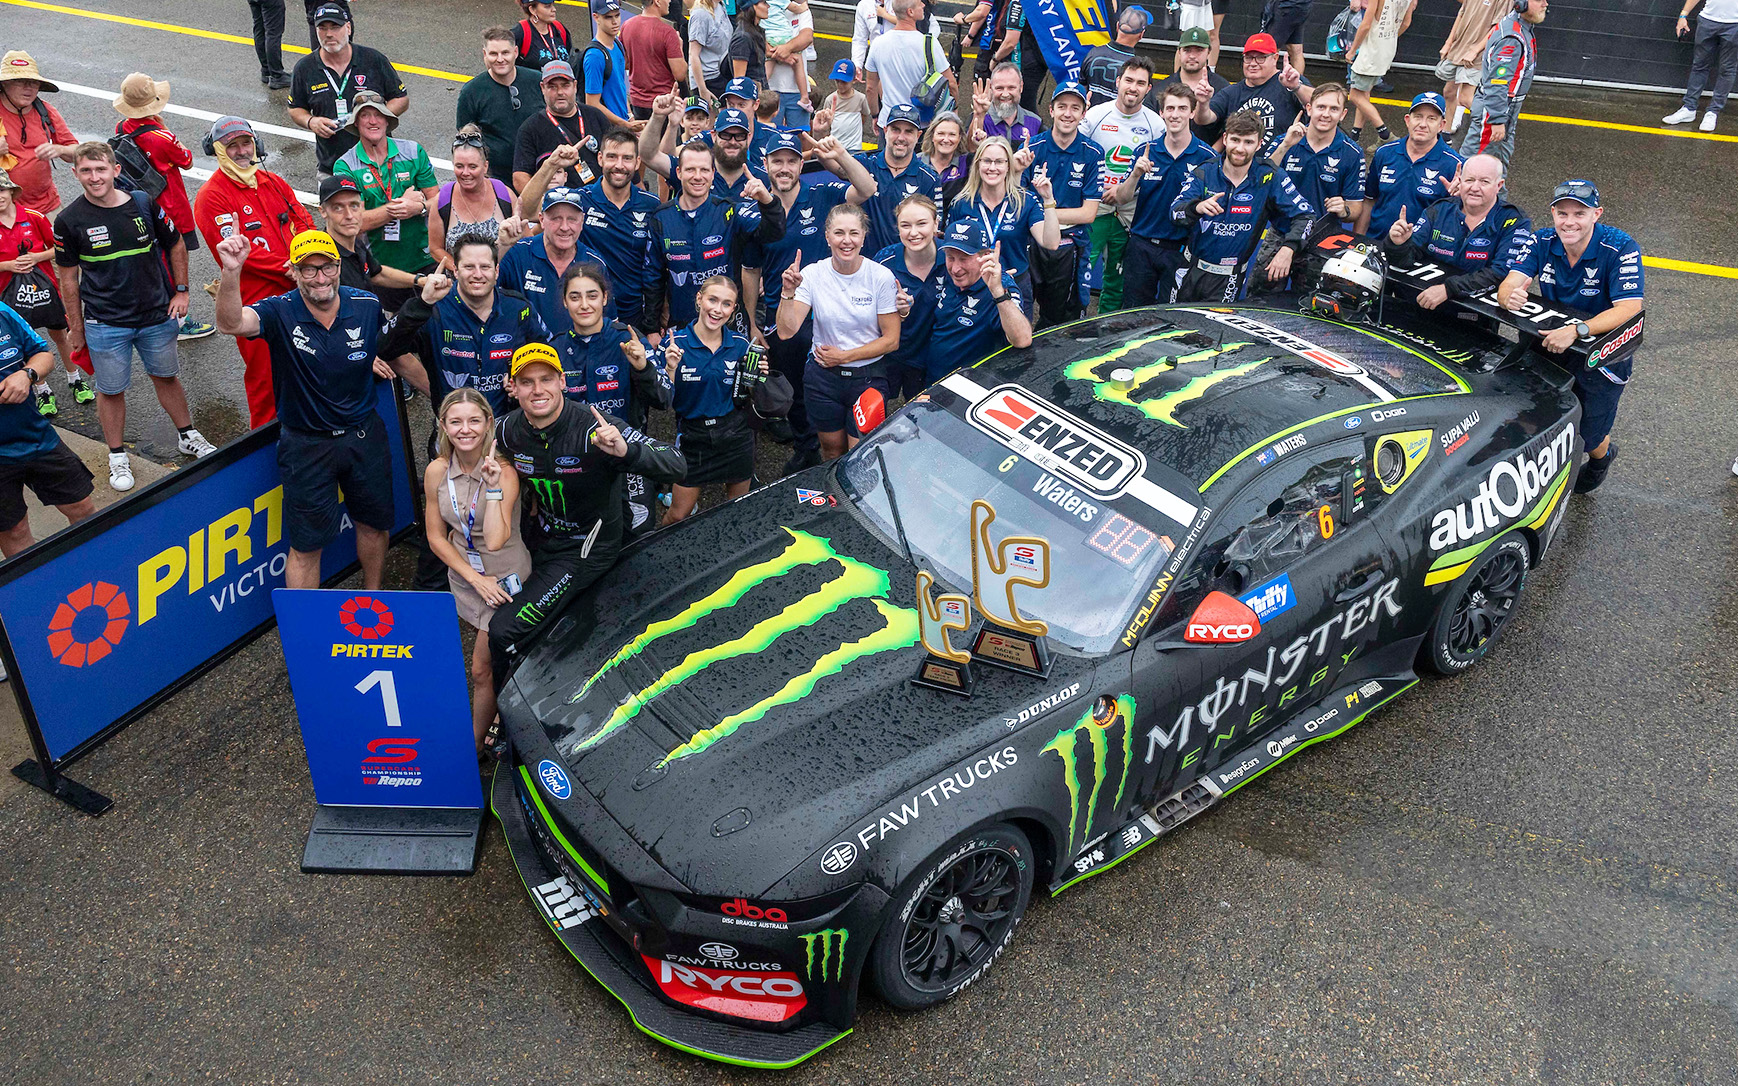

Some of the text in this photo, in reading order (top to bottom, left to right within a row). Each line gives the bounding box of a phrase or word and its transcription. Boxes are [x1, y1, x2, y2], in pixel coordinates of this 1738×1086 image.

[1049, 24, 1081, 81] LANE
[293, 238, 332, 250] DUNLOP
[1599, 316, 1645, 359] Castrol
[450, 349, 476, 359] Castrol
[490, 350, 513, 358] RYCO
[514, 348, 557, 363] DUNLOP
[470, 373, 507, 386] TICKFO
[598, 381, 619, 389] RYCO
[1384, 407, 1408, 419] OGIO
[1440, 409, 1480, 448] SUPA VALU
[1018, 414, 1123, 482] ENZED
[1272, 433, 1308, 458] WATERS
[998, 454, 1019, 473] 6
[1032, 472, 1098, 522] Waters
[1318, 504, 1335, 540] 6
[1169, 506, 1213, 575] electrical
[137, 483, 284, 627] PIRT
[209, 551, 289, 613] VICTO
[1245, 582, 1289, 616] Thrifty
[1189, 623, 1254, 639] RYCO
[331, 643, 414, 659] PIRTEK
[1144, 576, 1403, 765] MONSTER
[353, 669, 402, 727] 1
[1017, 682, 1081, 724] DUNLOP
[1181, 645, 1359, 771] ENERGY
[1344, 691, 1360, 709] P1
[1316, 708, 1340, 725] OGIO
[1279, 733, 1299, 750] Miller
[377, 775, 423, 787] Repco
[1218, 756, 1261, 785] DesignEars
[857, 746, 1019, 851] FAW TRUCKS
[1073, 853, 1095, 873] SPY
[720, 897, 788, 923] dba
[721, 916, 789, 930] DISC BRAKES AUSTRALIA
[665, 953, 782, 971] FAW TRUCKS
[661, 959, 804, 998] RYCO
